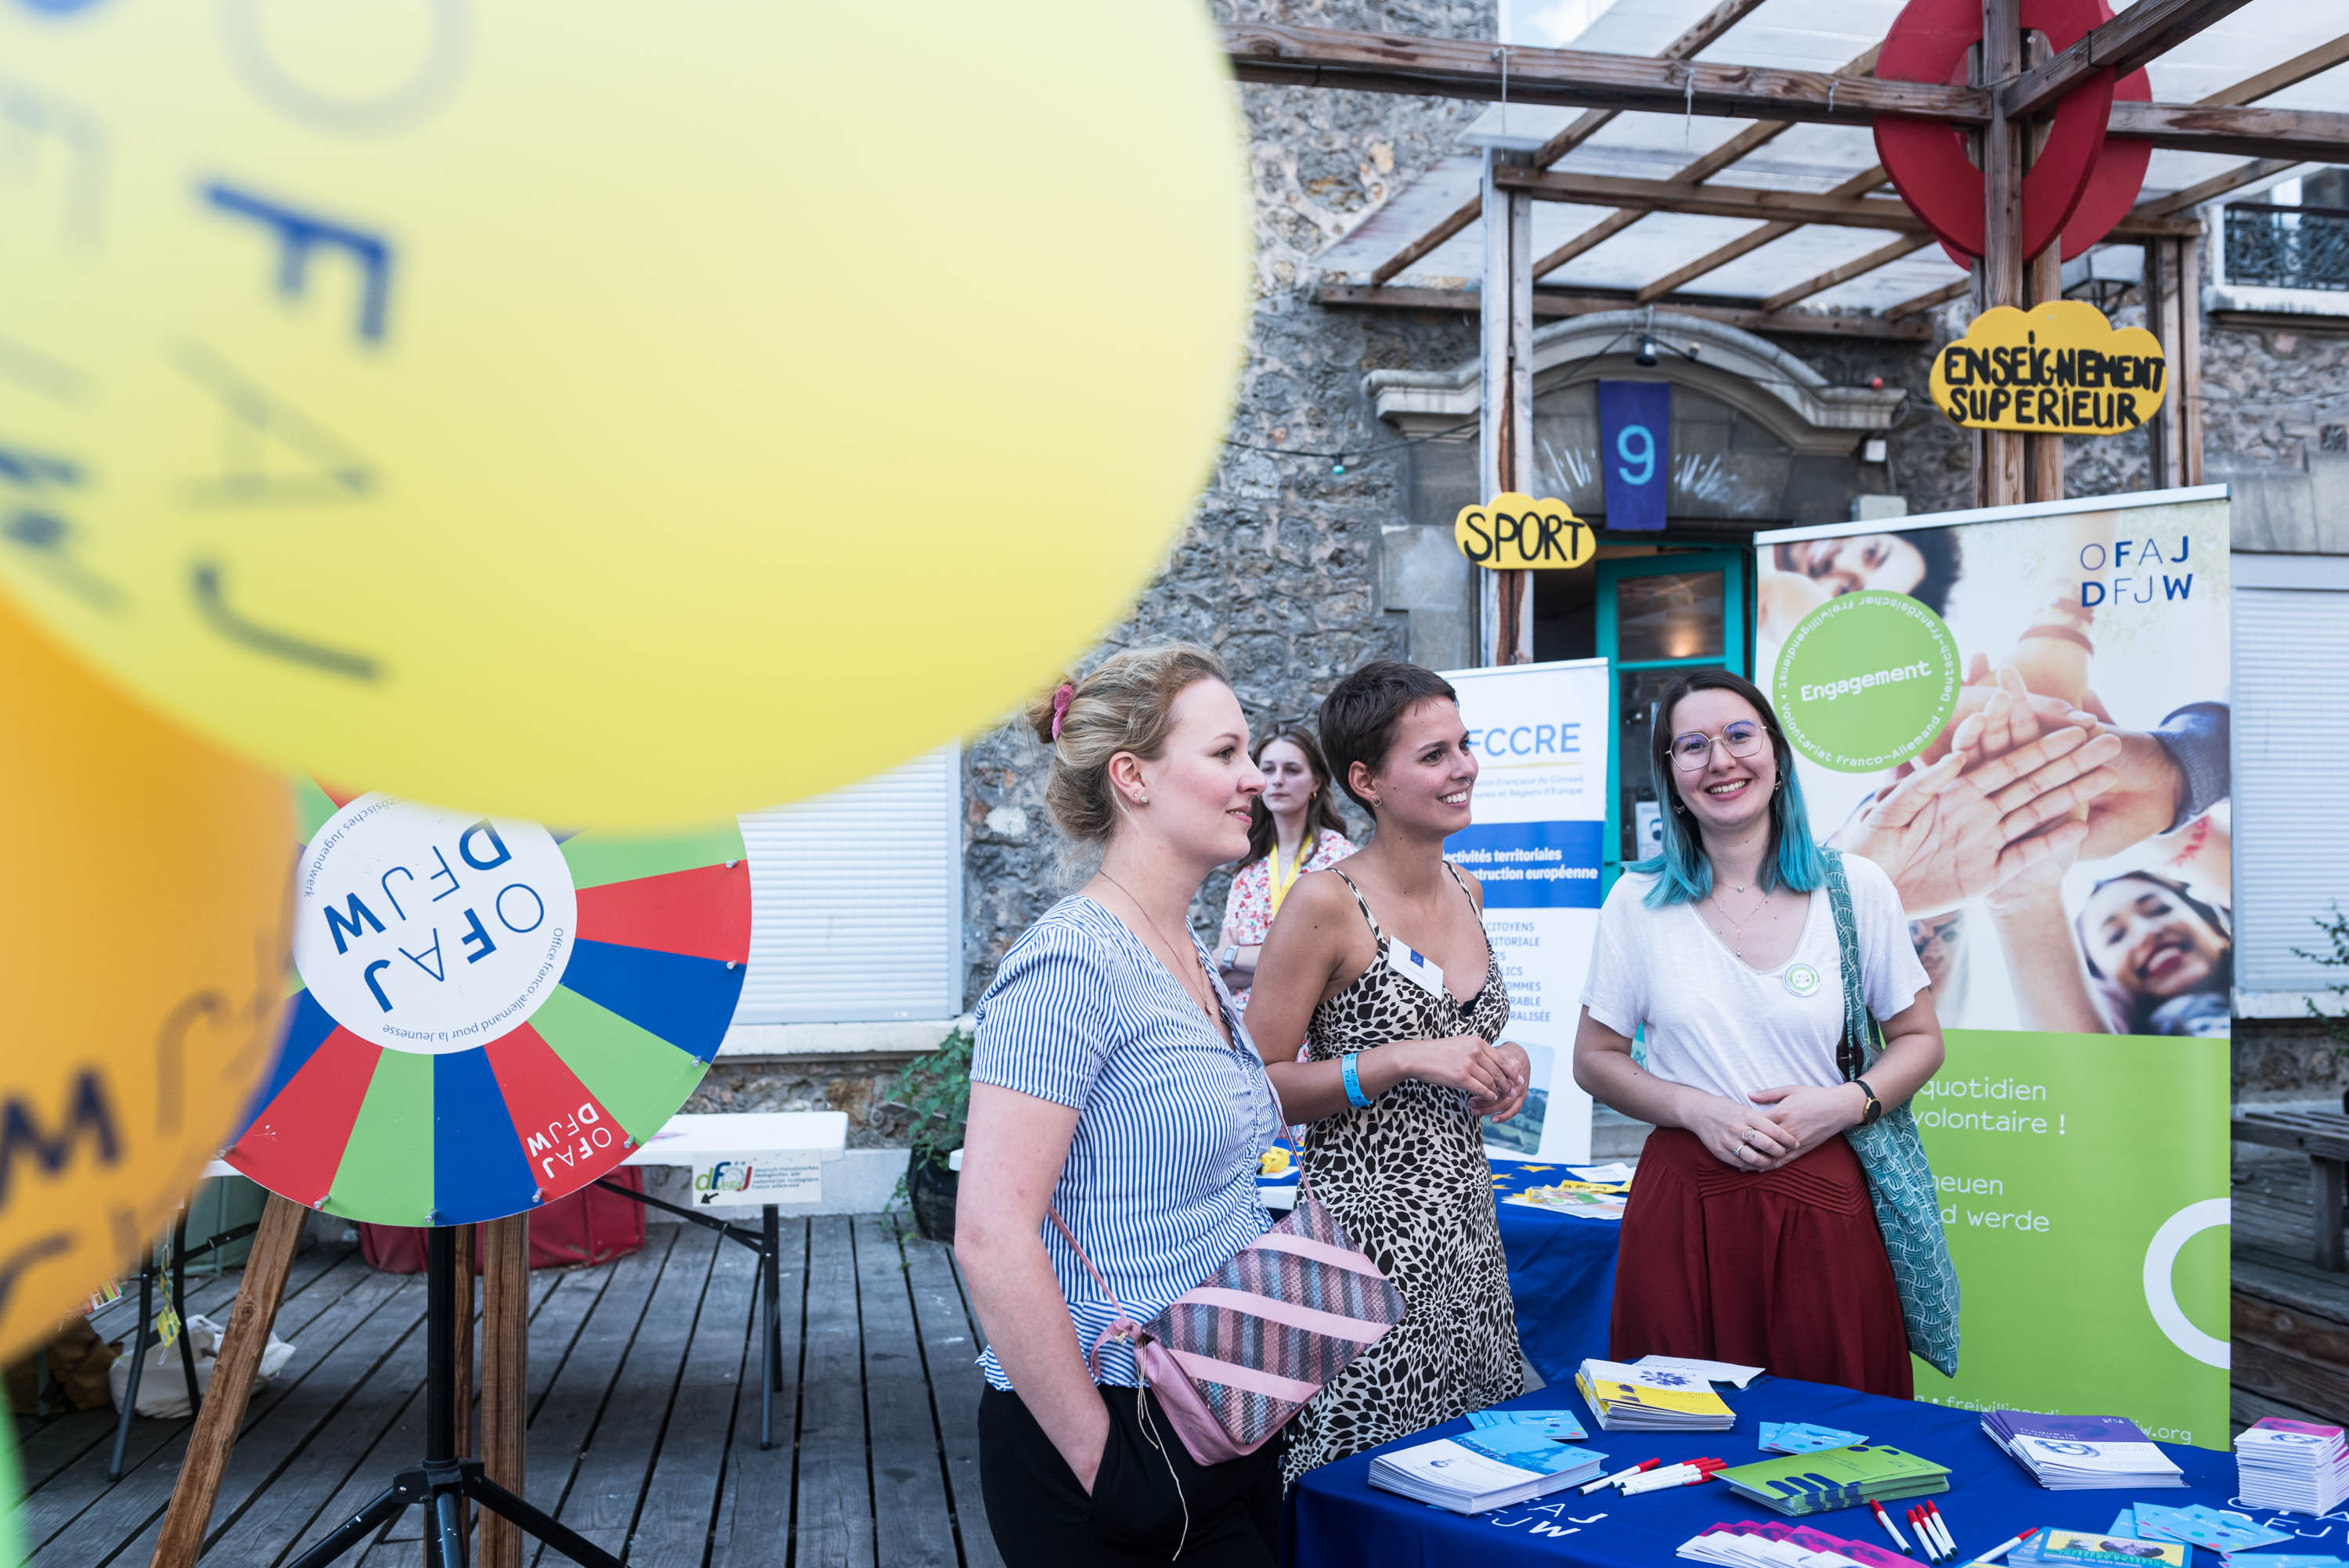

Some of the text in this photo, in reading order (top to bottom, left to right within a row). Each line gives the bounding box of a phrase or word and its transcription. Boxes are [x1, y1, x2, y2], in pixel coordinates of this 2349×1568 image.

[1617, 424, 1656, 485] 9
[1464, 512, 1586, 562] SPORT
[1800, 660, 1932, 702] Engagement
[1550, 774, 1583, 784] Conseil
[303, 828, 345, 898] Jugendwerk
[1493, 846, 1562, 863] territoriales
[1470, 863, 1599, 882] struction européenne
[1485, 921, 1535, 932] CITOYENS
[382, 927, 565, 1043] Office franco-allemand pour la Jeunesse
[1505, 981, 1541, 992] OMMES
[1919, 1076, 2047, 1101] quotidien
[1911, 1107, 2048, 1134] volontaire
[1940, 1203, 2049, 1232] d werde
